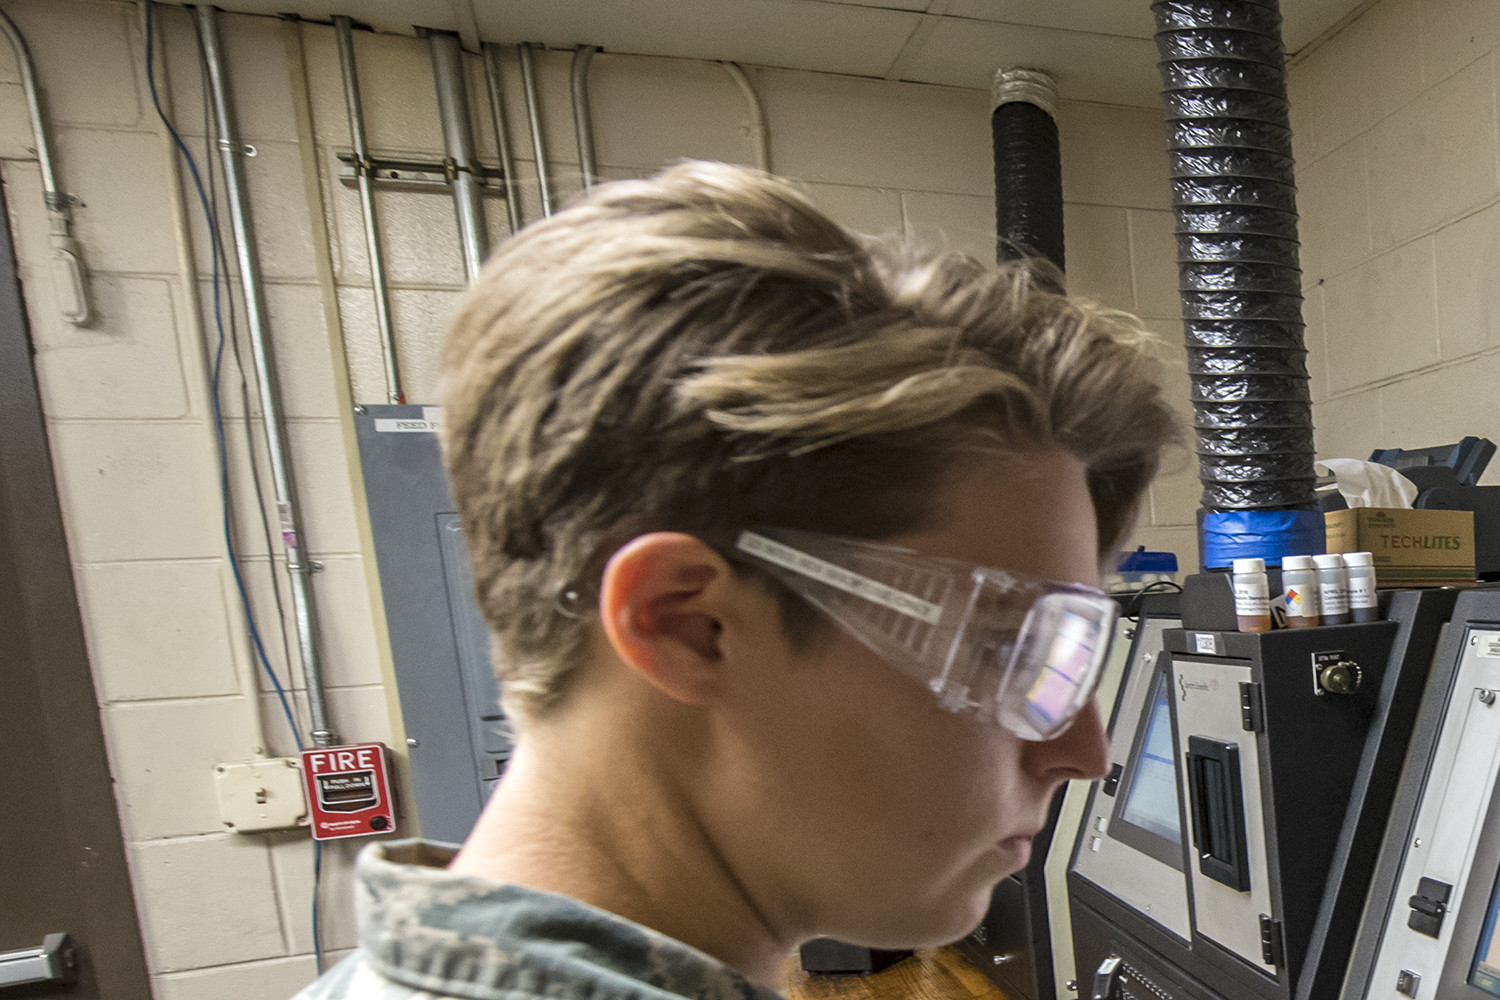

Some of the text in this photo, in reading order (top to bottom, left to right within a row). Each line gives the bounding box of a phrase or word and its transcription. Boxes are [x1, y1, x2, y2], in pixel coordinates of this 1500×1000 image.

[395, 421, 427, 430] FEED
[1380, 535, 1460, 550] TECHLITES
[310, 750, 375, 772] FIRE
